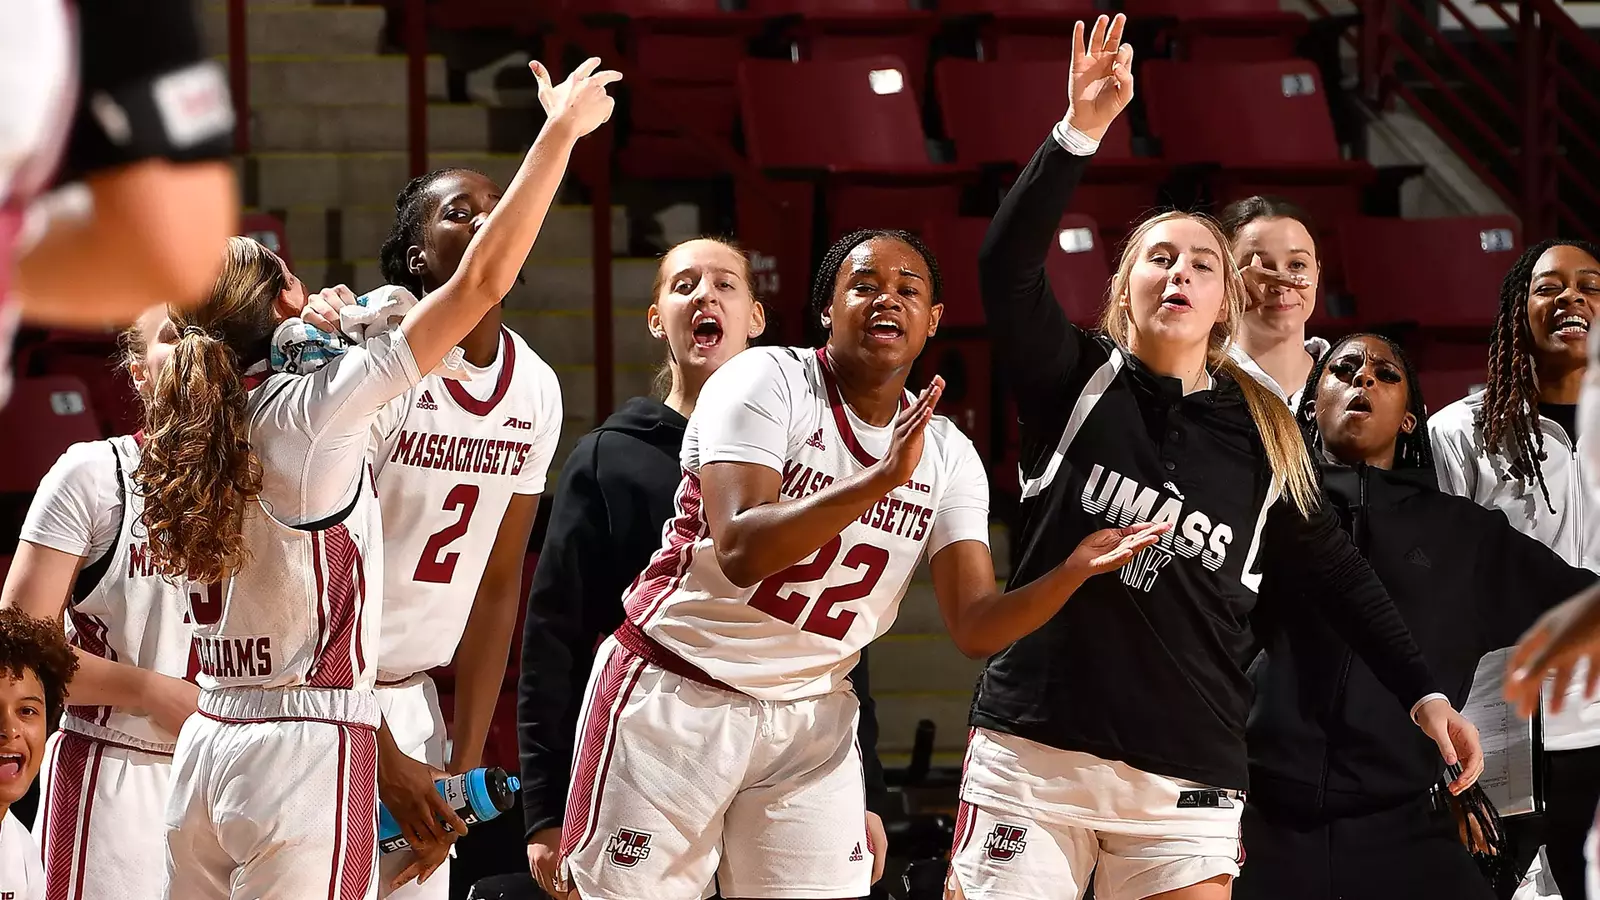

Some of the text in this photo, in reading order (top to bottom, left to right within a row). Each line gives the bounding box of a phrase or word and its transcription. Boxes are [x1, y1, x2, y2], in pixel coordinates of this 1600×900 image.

[416, 402, 438, 410] adidas
[502, 417, 532, 430] A10
[412, 484, 480, 584] 2
[781, 458, 934, 542] MASSUSETTS
[1081, 463, 1234, 572] UMASS
[747, 532, 890, 641] 22
